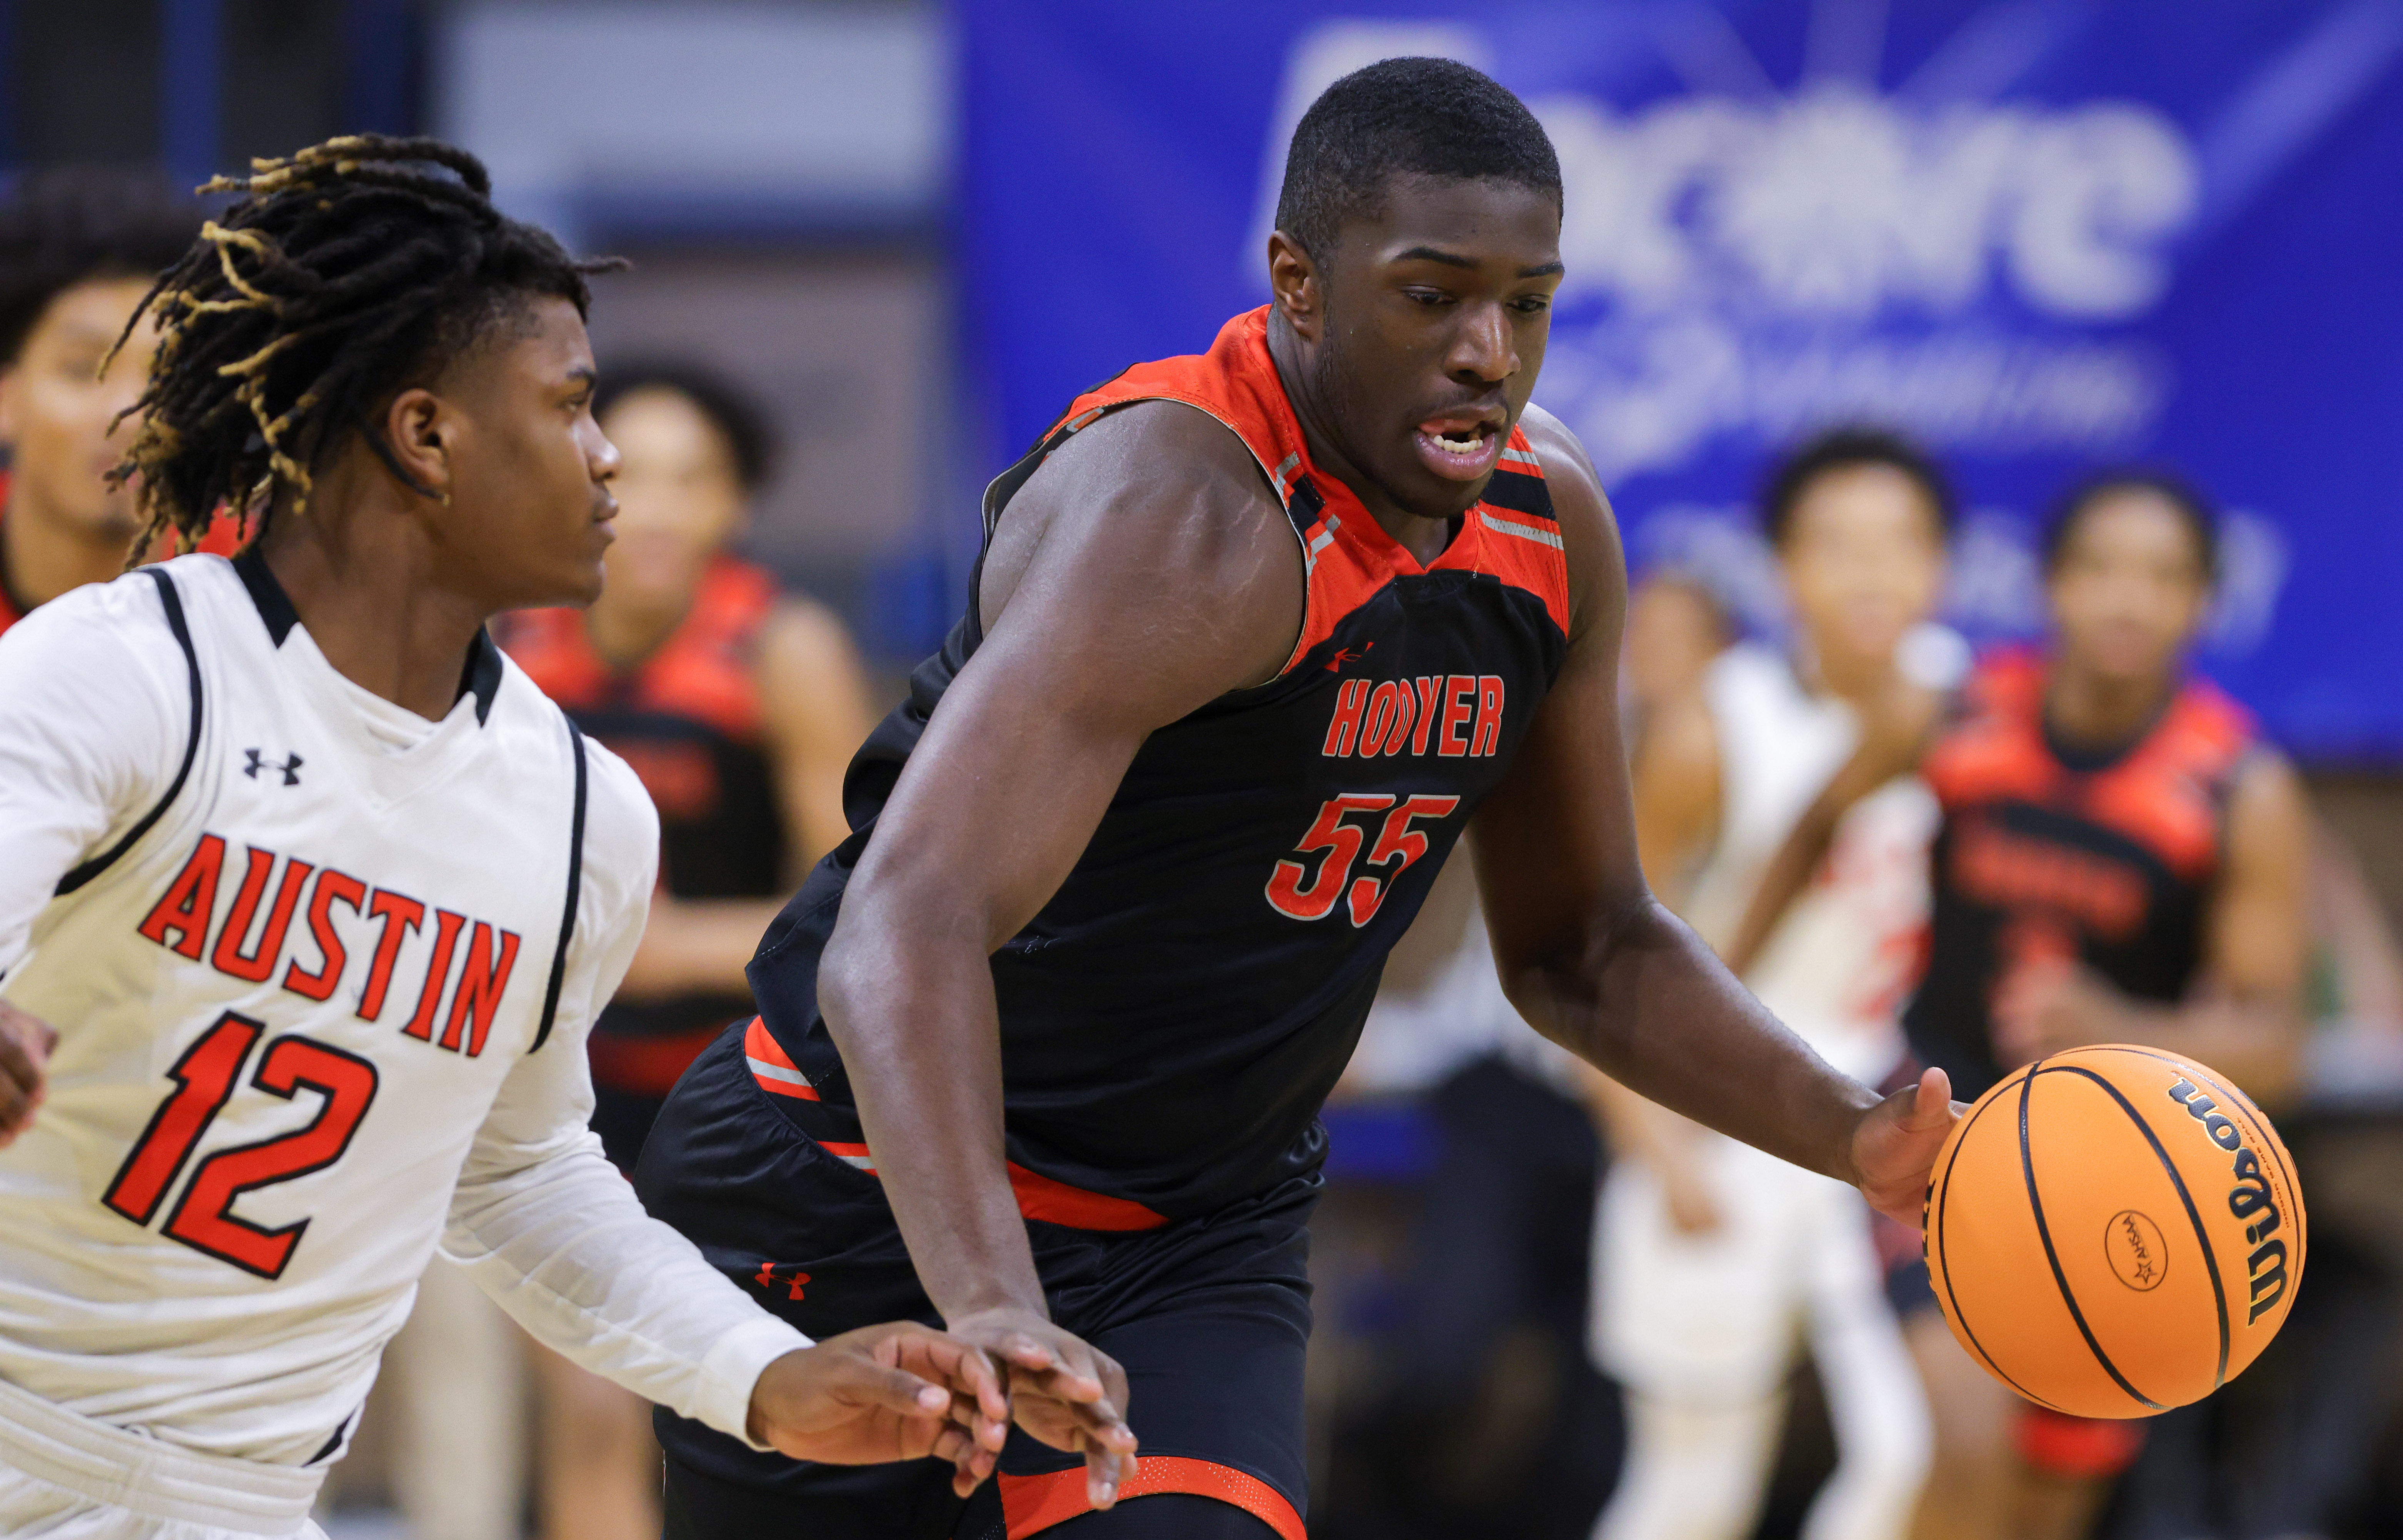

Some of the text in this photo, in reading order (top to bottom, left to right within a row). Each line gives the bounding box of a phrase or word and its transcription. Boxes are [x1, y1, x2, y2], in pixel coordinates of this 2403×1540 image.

[1322, 675, 1505, 758] HOOVER
[137, 832, 522, 1058] AUSTIN
[1264, 793, 1461, 928] 55
[101, 1009, 379, 1281] 12
[2167, 1076, 2287, 1327] Wilson
[2123, 1214, 2150, 1260] AHSAA
